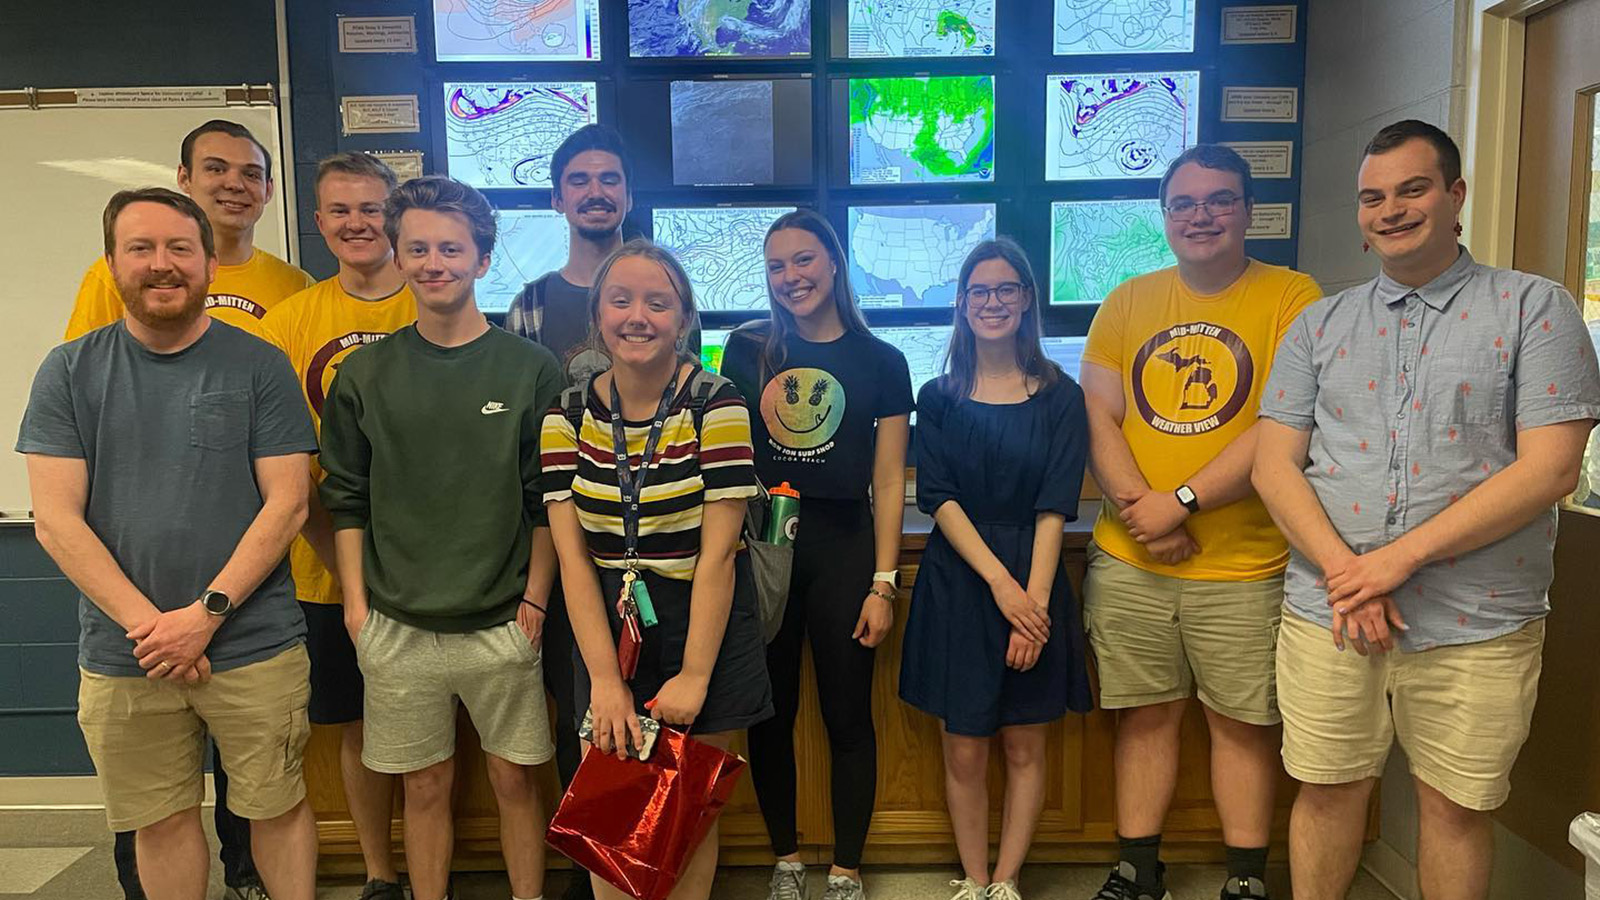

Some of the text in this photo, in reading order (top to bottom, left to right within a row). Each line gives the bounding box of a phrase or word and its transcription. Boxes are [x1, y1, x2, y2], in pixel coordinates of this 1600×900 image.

[205, 295, 255, 313] ID-MITTEN
[1169, 323, 1221, 339] MID-MITTEN
[1151, 415, 1220, 434] WEATHER VIEW
